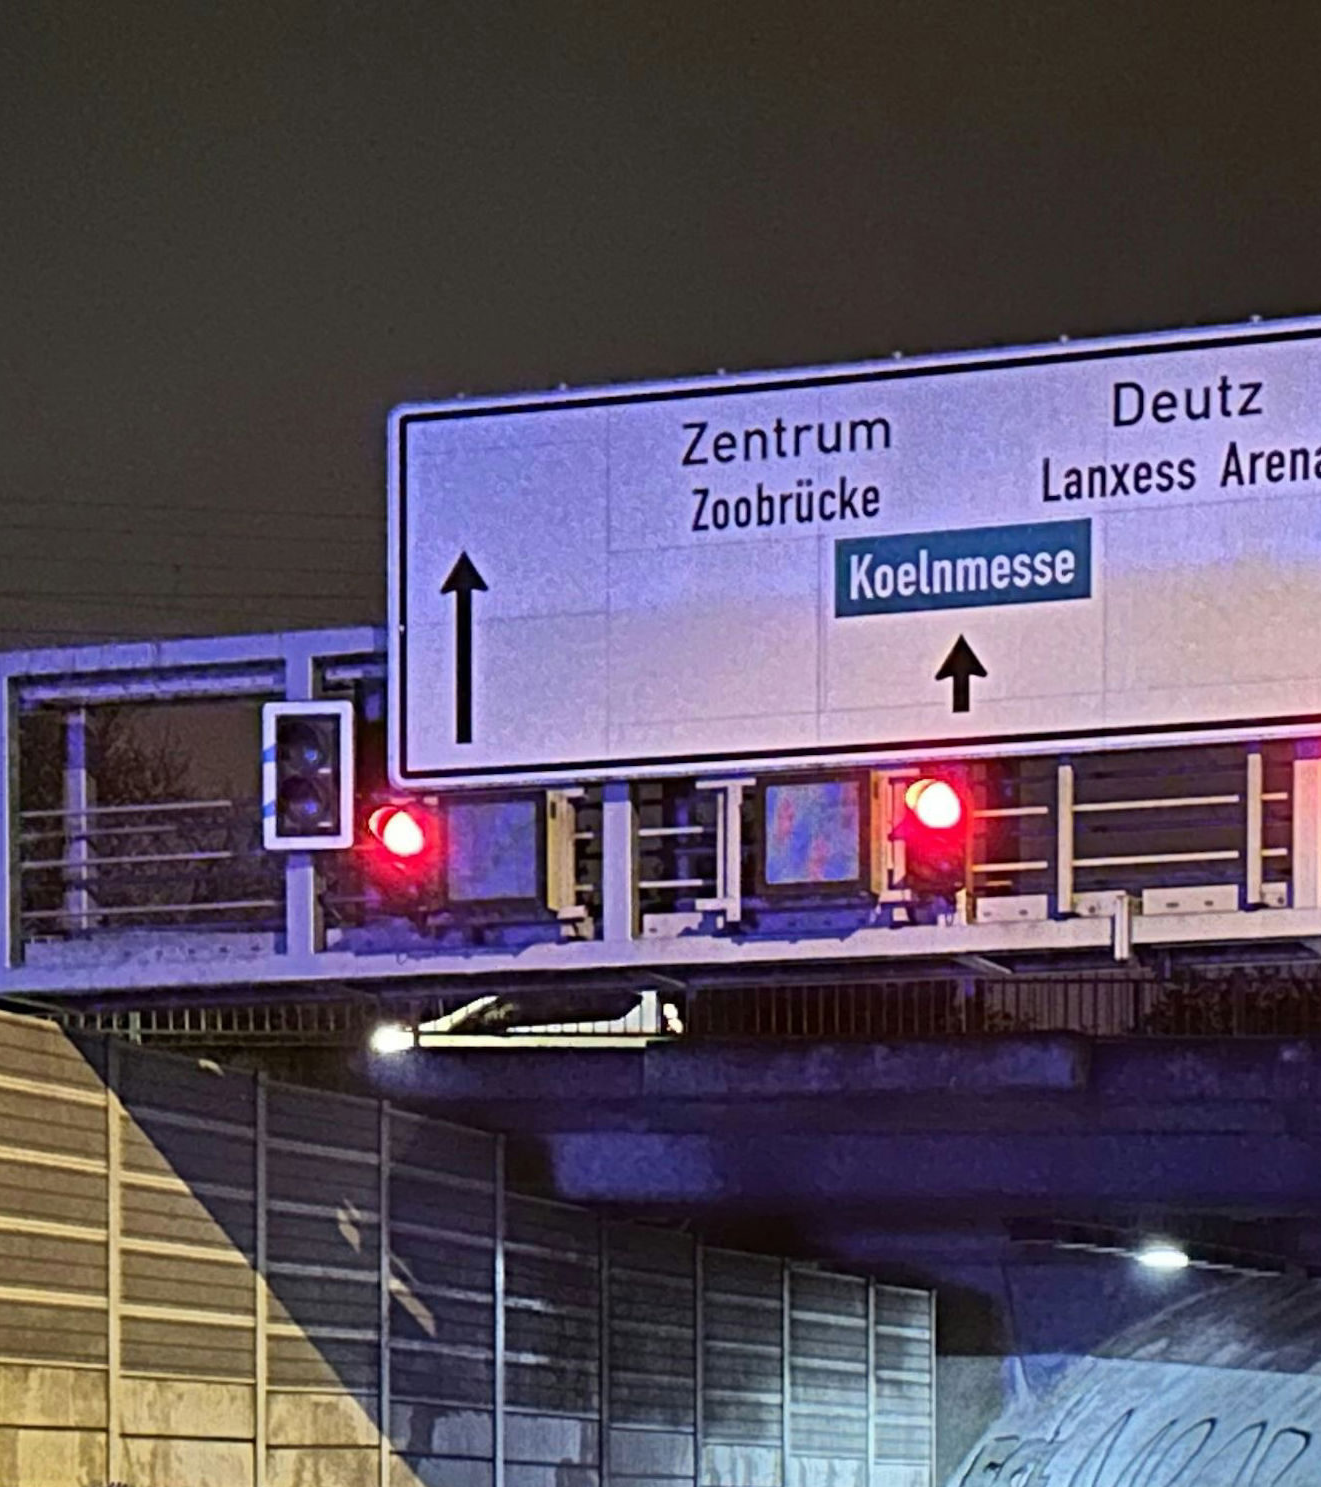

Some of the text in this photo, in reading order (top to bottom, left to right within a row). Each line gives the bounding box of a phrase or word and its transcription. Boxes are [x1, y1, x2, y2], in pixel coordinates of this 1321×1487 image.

[1113, 375, 1263, 428] Deutz
[681, 416, 892, 467] Zentrum
[691, 475, 881, 532] Zoobrücke
[1042, 457, 1197, 503] Lanxess
[848, 546, 1077, 602] Koelnmesse
